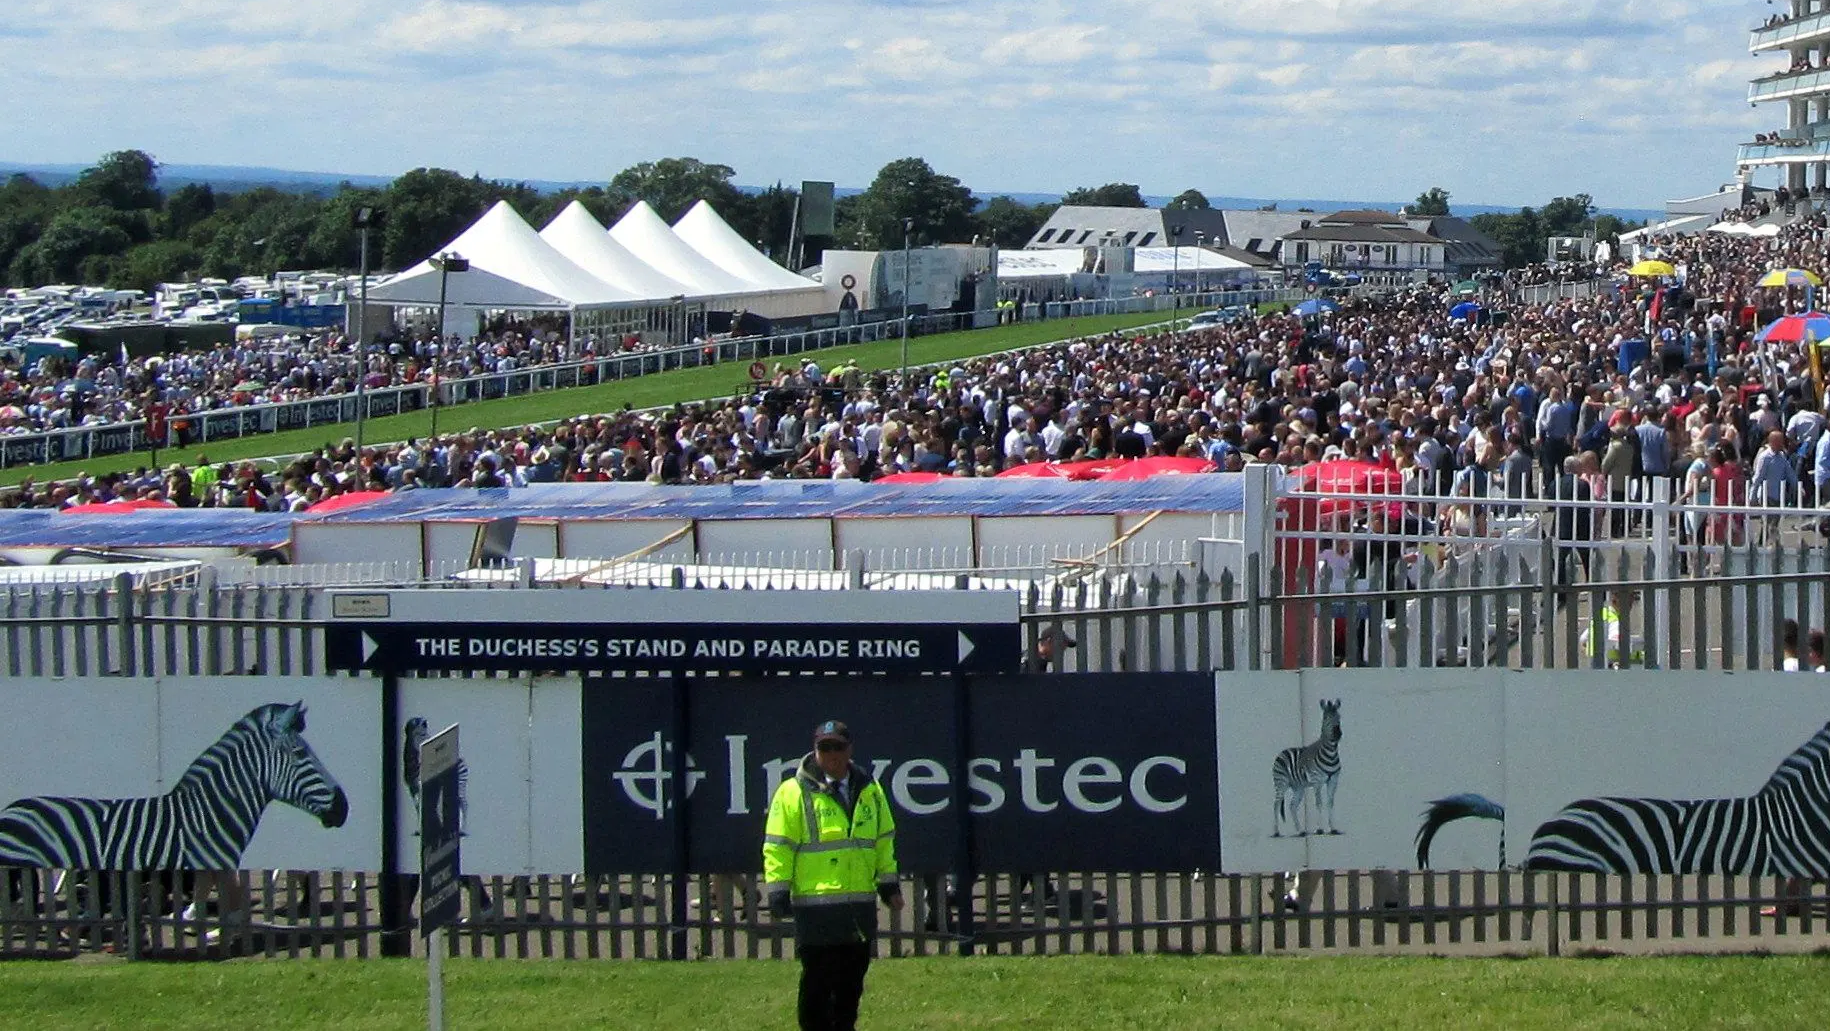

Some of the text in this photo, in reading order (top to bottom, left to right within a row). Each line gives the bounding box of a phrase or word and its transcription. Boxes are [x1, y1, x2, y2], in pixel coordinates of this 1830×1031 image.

[416, 637, 921, 658] THE DUCHESS'S STAND AND PARADE RING
